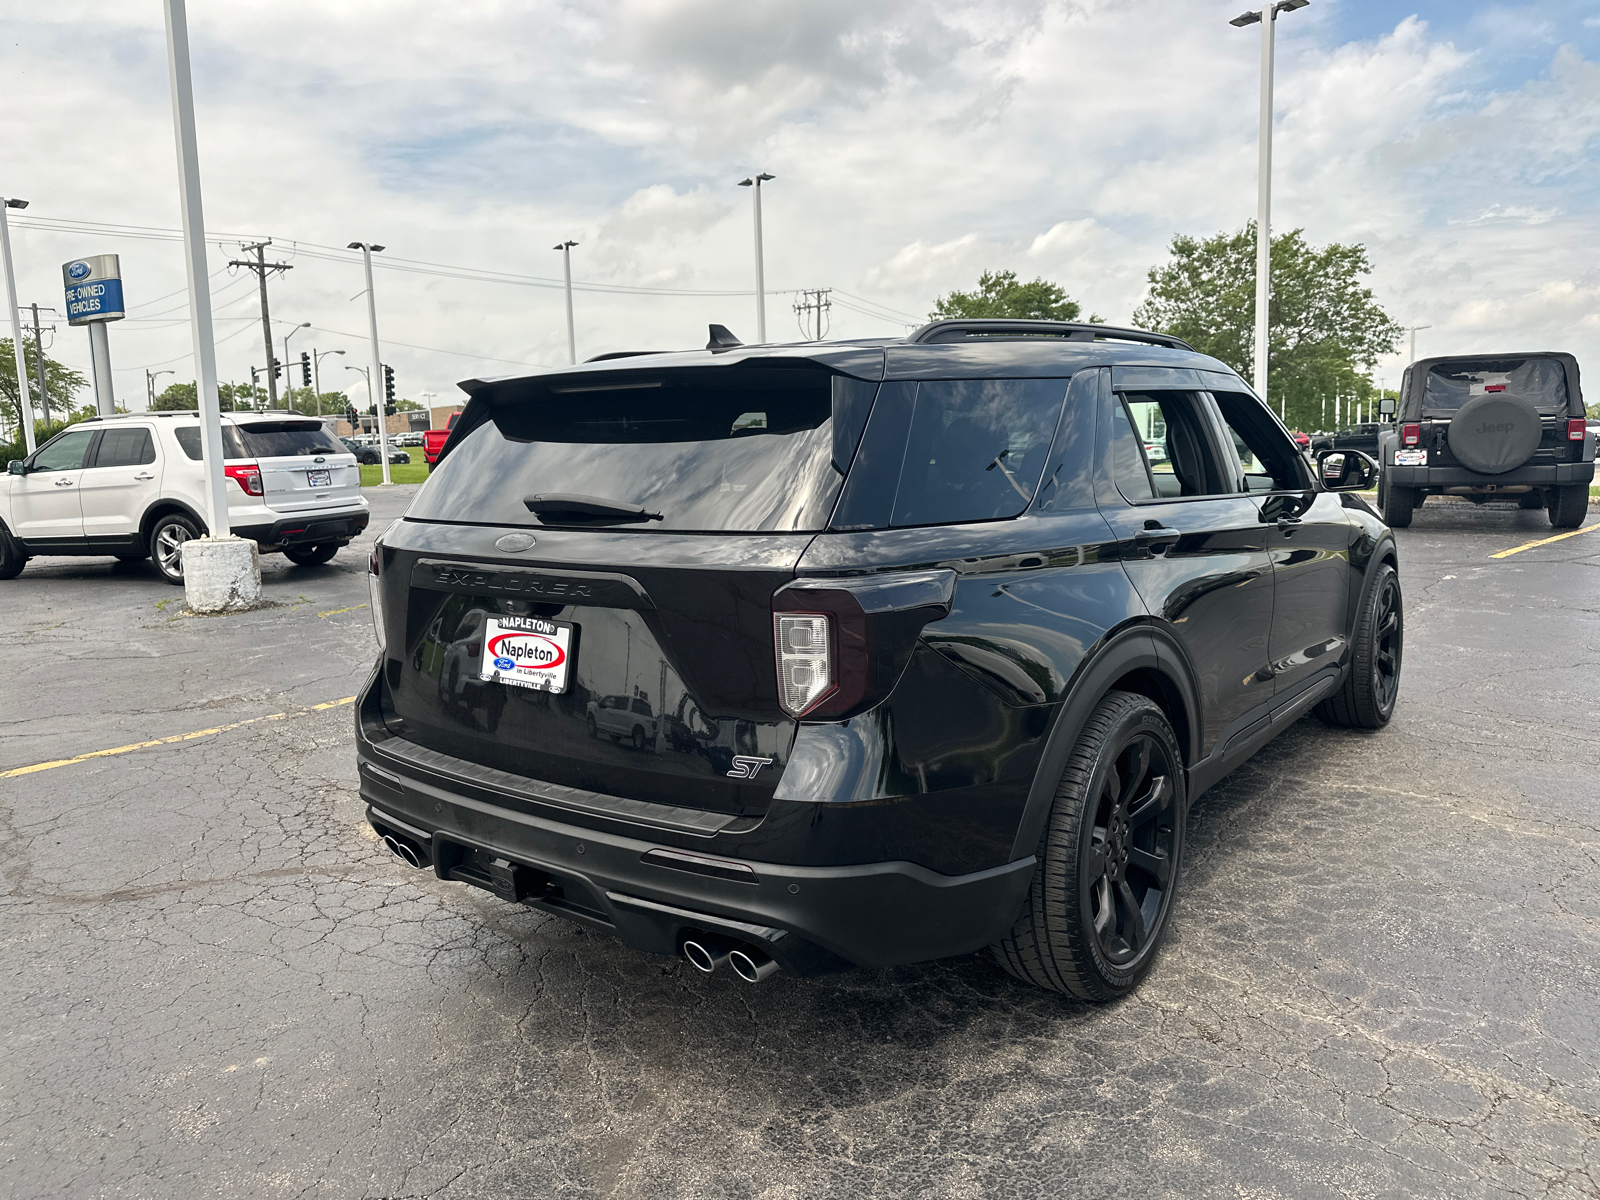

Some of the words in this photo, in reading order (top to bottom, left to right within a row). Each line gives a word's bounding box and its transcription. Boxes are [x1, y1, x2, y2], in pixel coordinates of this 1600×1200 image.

[71, 264, 84, 276] Ford
[66, 284, 105, 302] PRE-OWNED
[69, 299, 101, 315] VEHICLES
[1476, 422, 1515, 434] Jeep
[435, 572, 592, 597] EXPLORER
[502, 617, 551, 634] NAPLETON
[501, 639, 553, 662] Napleton
[497, 658, 512, 669] Ford
[523, 668, 557, 680] Libertyville
[499, 677, 541, 691] LIBERTYVILLE
[726, 754, 774, 779] ST
